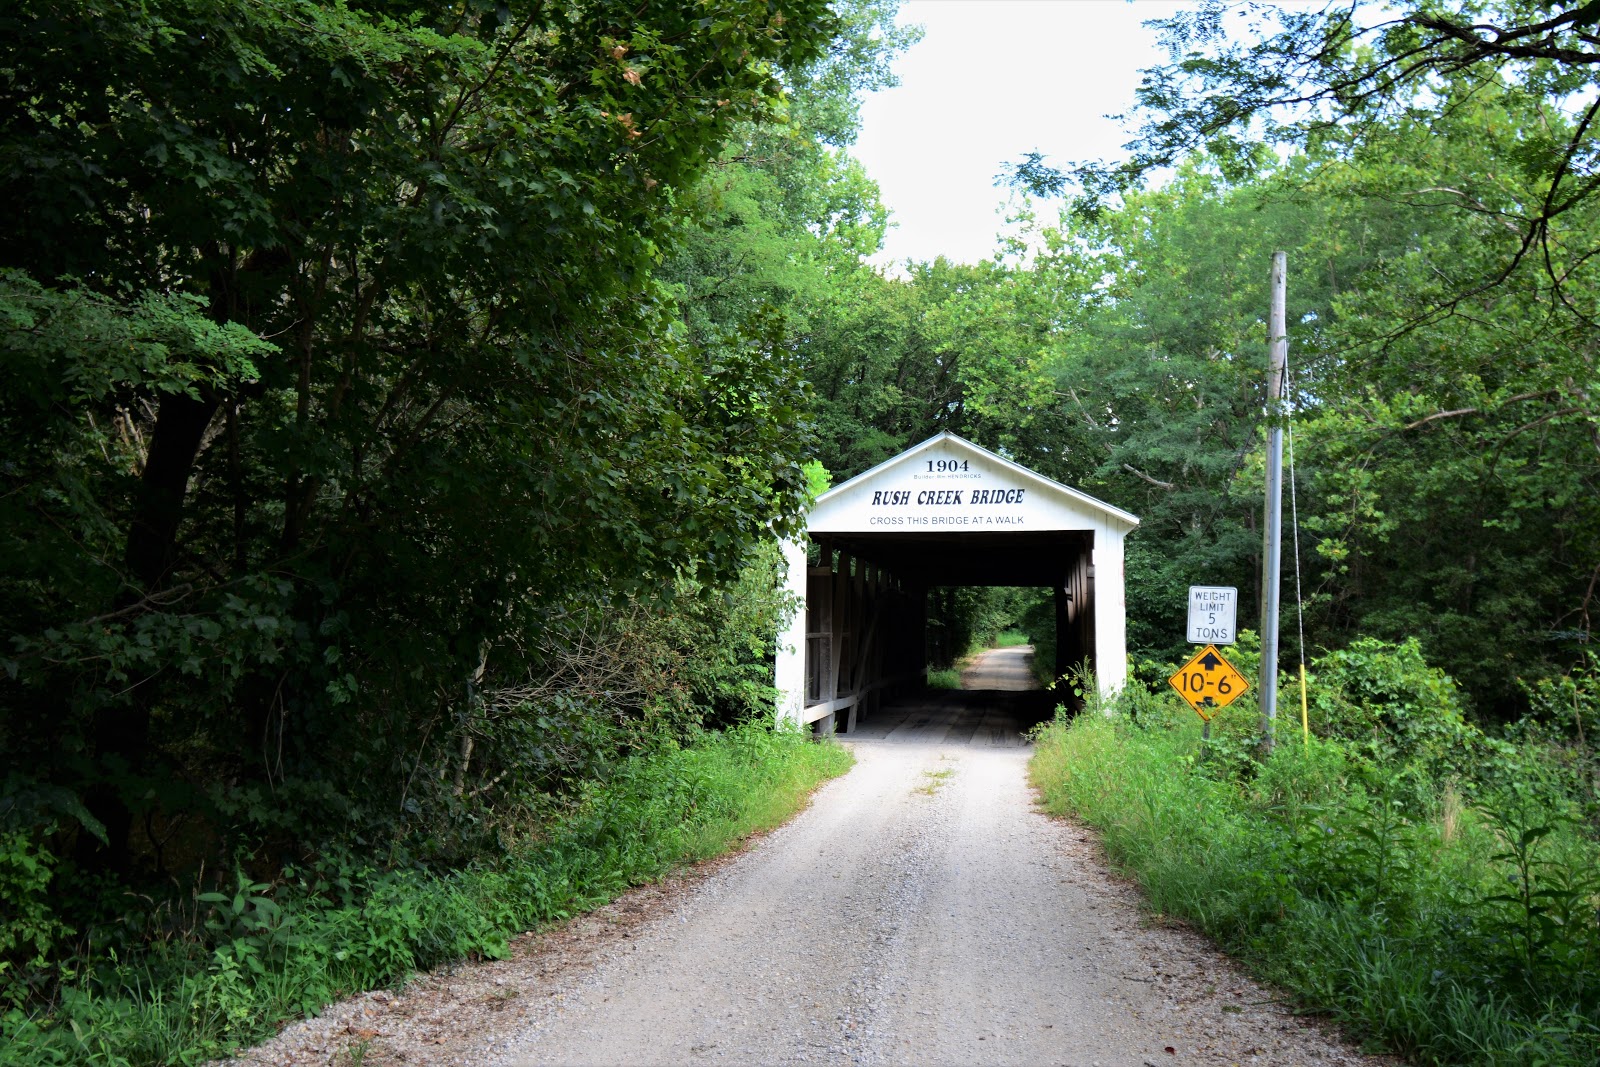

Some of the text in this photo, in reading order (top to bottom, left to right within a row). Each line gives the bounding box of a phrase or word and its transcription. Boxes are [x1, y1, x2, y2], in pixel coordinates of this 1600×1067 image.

[926, 460, 969, 472] 1904
[871, 489, 1025, 505] RUSH CREEK BRIDGE
[870, 516, 1024, 525] CROSS THIS BRIDGE AT A WALK
[1195, 592, 1231, 601] WEIGHT
[1200, 603, 1225, 612] LIMIT
[1208, 613, 1216, 624] 5
[1196, 628, 1228, 639] TONS
